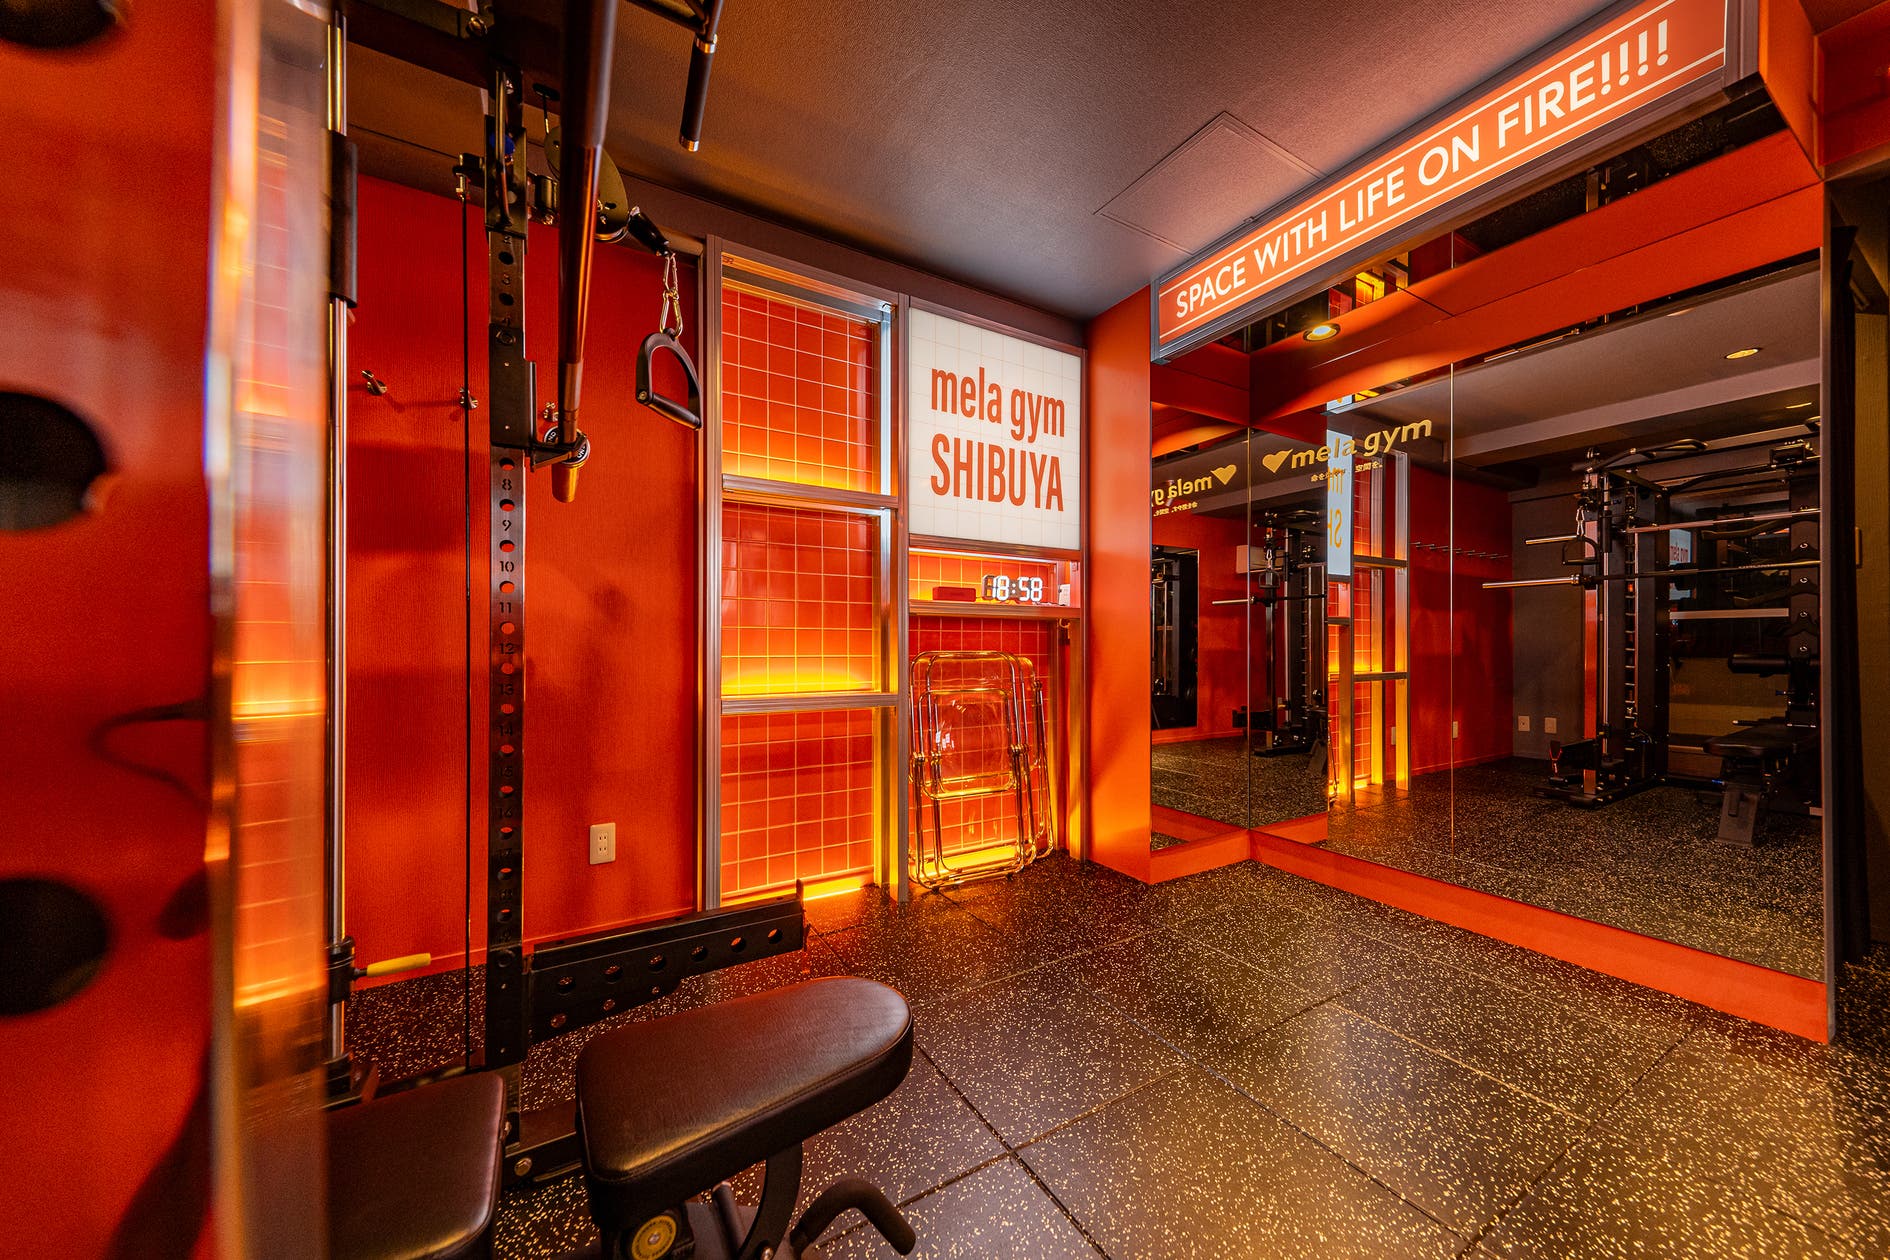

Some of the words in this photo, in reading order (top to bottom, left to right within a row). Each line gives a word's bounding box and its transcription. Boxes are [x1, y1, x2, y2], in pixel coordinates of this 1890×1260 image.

[1176, 256, 1246, 319] SPACE
[1253, 216, 1328, 275] WITH
[1339, 165, 1406, 232] LIFE
[1418, 124, 1481, 187] ON
[1497, 19, 1669, 149] FIRE!!!!
[931, 366, 1003, 425] mela
[1010, 387, 1066, 444] gym
[1291, 437, 1358, 469] mela
[1363, 419, 1433, 457] gym
[930, 433, 1064, 512] SHIBUYA
[501, 478, 513, 491] 8
[502, 518, 513, 532] 9
[499, 560, 515, 574] 10
[988, 575, 1043, 602] 18:58
[499, 601, 513, 614] 11
[499, 642, 515, 655] 12
[499, 683, 514, 696] 13
